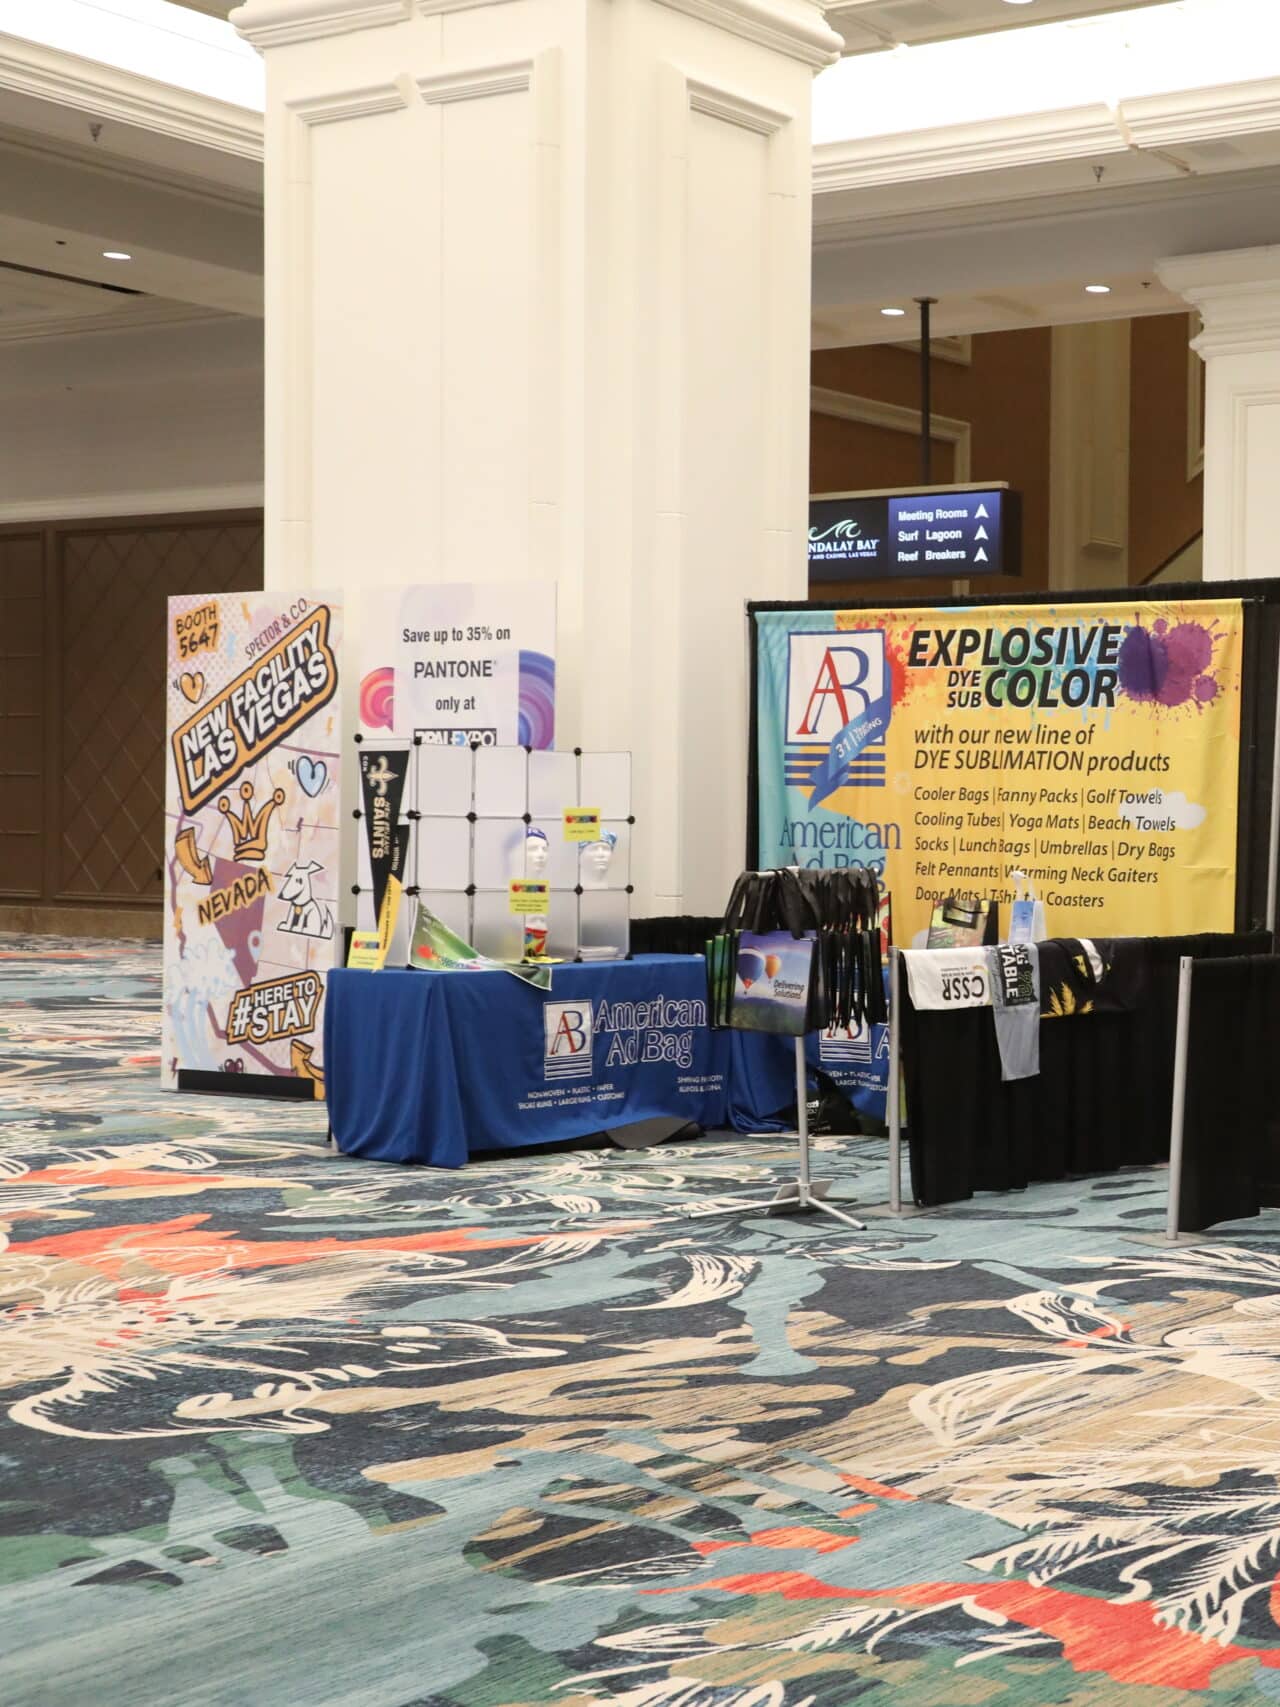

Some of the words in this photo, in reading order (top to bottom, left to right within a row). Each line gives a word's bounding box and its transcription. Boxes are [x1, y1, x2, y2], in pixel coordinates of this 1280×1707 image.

[898, 511, 934, 522] Meeting
[936, 509, 968, 519] Rooms
[808, 541, 854, 553] NDALAY
[857, 539, 878, 551] BAY
[898, 531, 919, 542] Surf
[926, 530, 962, 542] Lagoon
[898, 551, 919, 562] Reef
[925, 550, 966, 561] Breakers
[176, 605, 217, 634] BOOTH
[180, 623, 218, 657] 5647
[245, 622, 280, 659] SPECTOR
[282, 614, 291, 628] &
[402, 628, 430, 643] Save
[434, 630, 448, 645] up
[452, 627, 463, 641] to
[467, 626, 492, 641] 35%
[496, 628, 511, 640] on
[908, 626, 1121, 667] EXPLOSIVE
[414, 660, 493, 679] PANTONE
[948, 670, 981, 687] DYE
[181, 701, 228, 760] NEW
[231, 621, 320, 719] FACILITY
[947, 691, 981, 708] SUB
[985, 668, 1118, 708] COLOR
[435, 696, 460, 713] only
[463, 696, 476, 710] at
[186, 729, 237, 794] LAS
[238, 652, 327, 744] VEGAS
[915, 724, 953, 744] with
[958, 730, 990, 744] our
[995, 729, 1032, 744] new
[1036, 724, 1070, 744] line
[1076, 723, 1095, 744] of
[835, 738, 851, 758] 31
[915, 750, 950, 769] DYE
[955, 750, 1084, 771] SUBLIMATION
[1087, 750, 1170, 776] products
[914, 786, 955, 801] Cooler
[959, 787, 989, 804] Bags
[999, 788, 1036, 804] Fanny
[1040, 789, 1078, 803] Packs
[1087, 788, 1116, 804] Golf
[1120, 789, 1162, 805] Towels
[372, 797, 386, 859] SAINTS
[779, 816, 901, 849] American
[914, 812, 963, 829] Cooling
[967, 813, 1001, 827] Tubes
[1010, 814, 1042, 831] Yoga
[1046, 815, 1079, 829] Mats
[1088, 815, 1130, 830] Beach
[1136, 816, 1176, 831] Towels
[915, 837, 949, 851] Socks
[960, 838, 996, 852] Lunch
[1000, 839, 1030, 857] Bags
[1040, 840, 1108, 856] Umbrellas
[1118, 842, 1144, 859] Dry
[1149, 843, 1176, 861] Bags
[915, 862, 935, 876] Felt
[939, 863, 999, 878] Pennants
[1071, 867, 1104, 882] Neck
[1108, 868, 1158, 883] Gaiters
[198, 868, 271, 924] NEVADA
[916, 887, 944, 901] Door
[990, 889, 1035, 904] T-Shit
[1047, 892, 1105, 907] Coasters
[255, 983, 293, 1006] HERE
[296, 978, 316, 998] TO
[942, 975, 985, 1001] CSSR
[592, 994, 706, 1034] American
[605, 1028, 639, 1067] Ad
[641, 1030, 693, 1069] Bag
